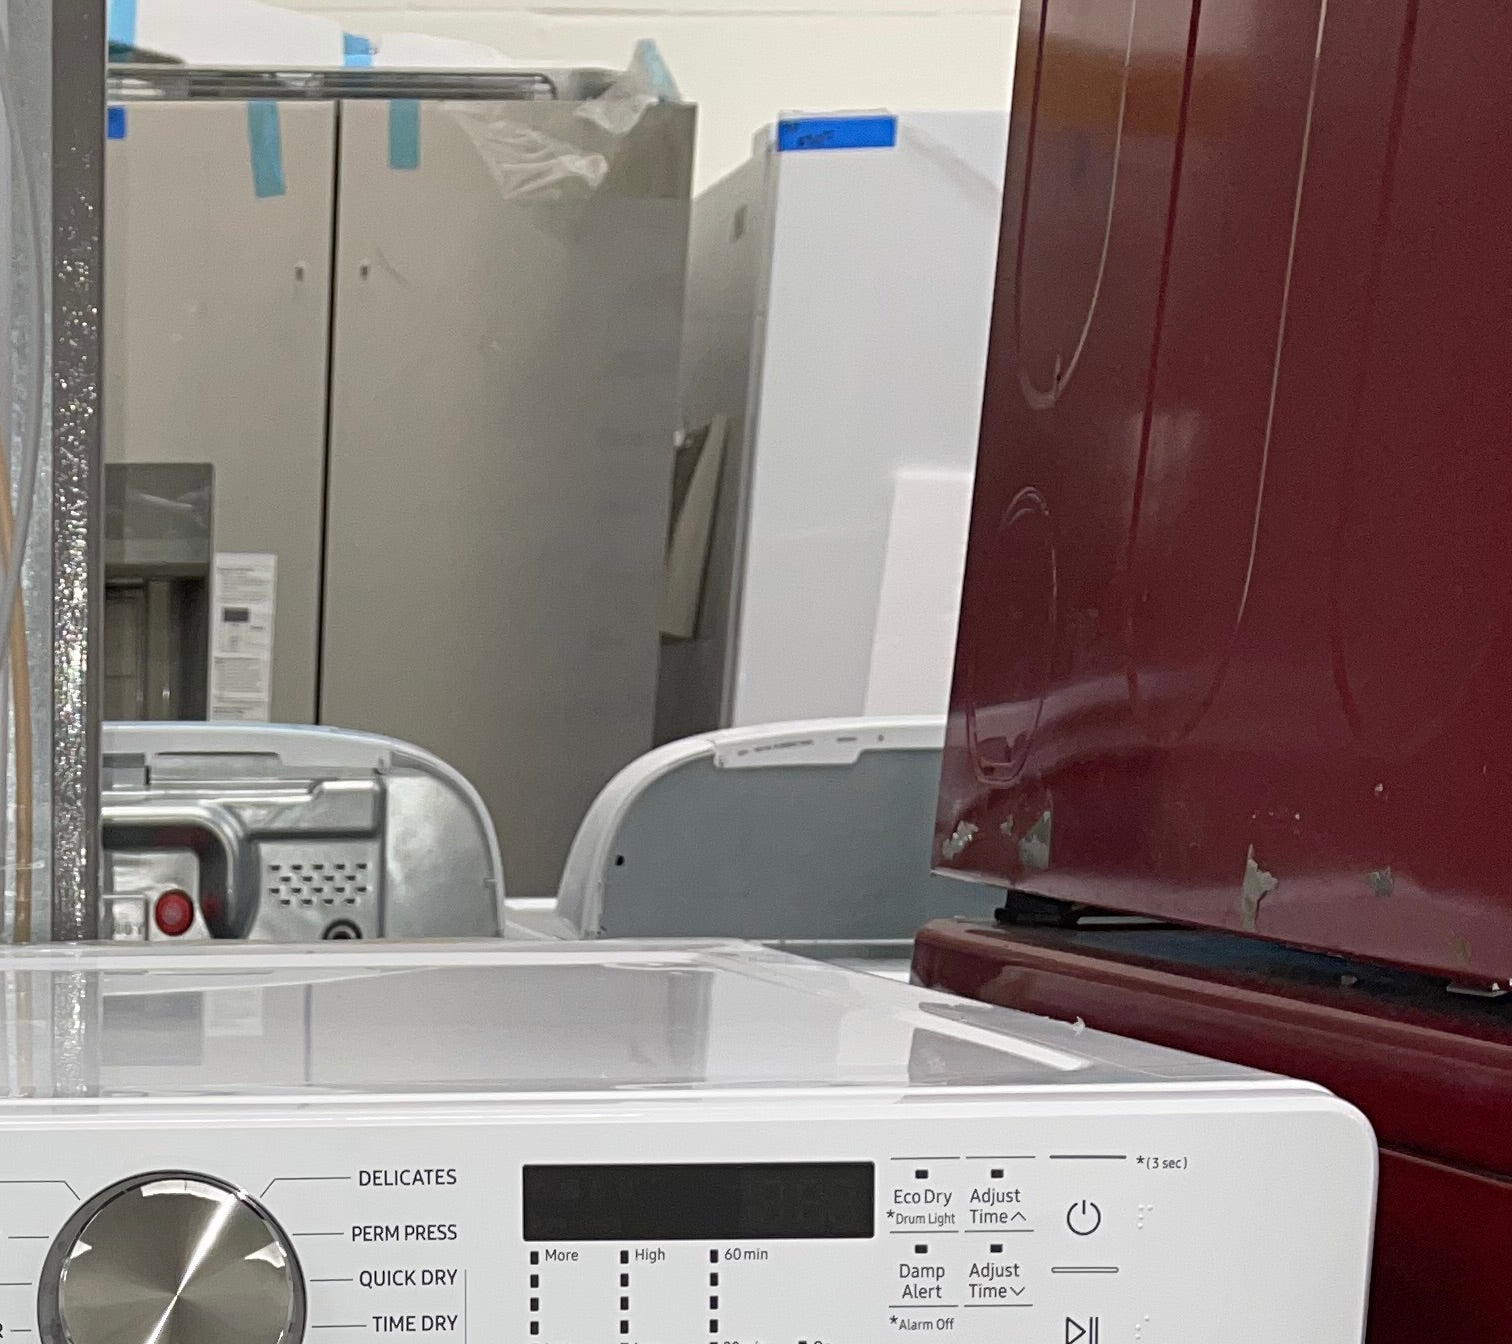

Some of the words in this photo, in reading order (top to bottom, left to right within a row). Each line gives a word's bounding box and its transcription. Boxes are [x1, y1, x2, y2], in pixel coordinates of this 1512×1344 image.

[359, 1168, 457, 1187] DELICATES
[893, 1189, 921, 1205] Eco
[924, 1188, 953, 1208] Dry
[969, 1187, 1021, 1207] Adjust
[928, 1212, 956, 1228] Light
[969, 1208, 1009, 1224] Time
[351, 1225, 400, 1242] PERM
[404, 1223, 458, 1241] PRESS
[545, 1248, 579, 1262] More
[635, 1247, 666, 1265] High
[724, 1247, 745, 1262] 60
[746, 1246, 769, 1261] min
[359, 1269, 415, 1289] QUICK
[421, 1268, 458, 1286] DRY
[899, 1263, 946, 1282] Damp
[968, 1262, 1020, 1282] Adjust
[901, 1283, 943, 1299] Alert
[968, 1283, 1008, 1299] Time
[371, 1315, 417, 1333] TIME
[421, 1314, 458, 1332] DRY
[936, 1317, 955, 1331] Off
